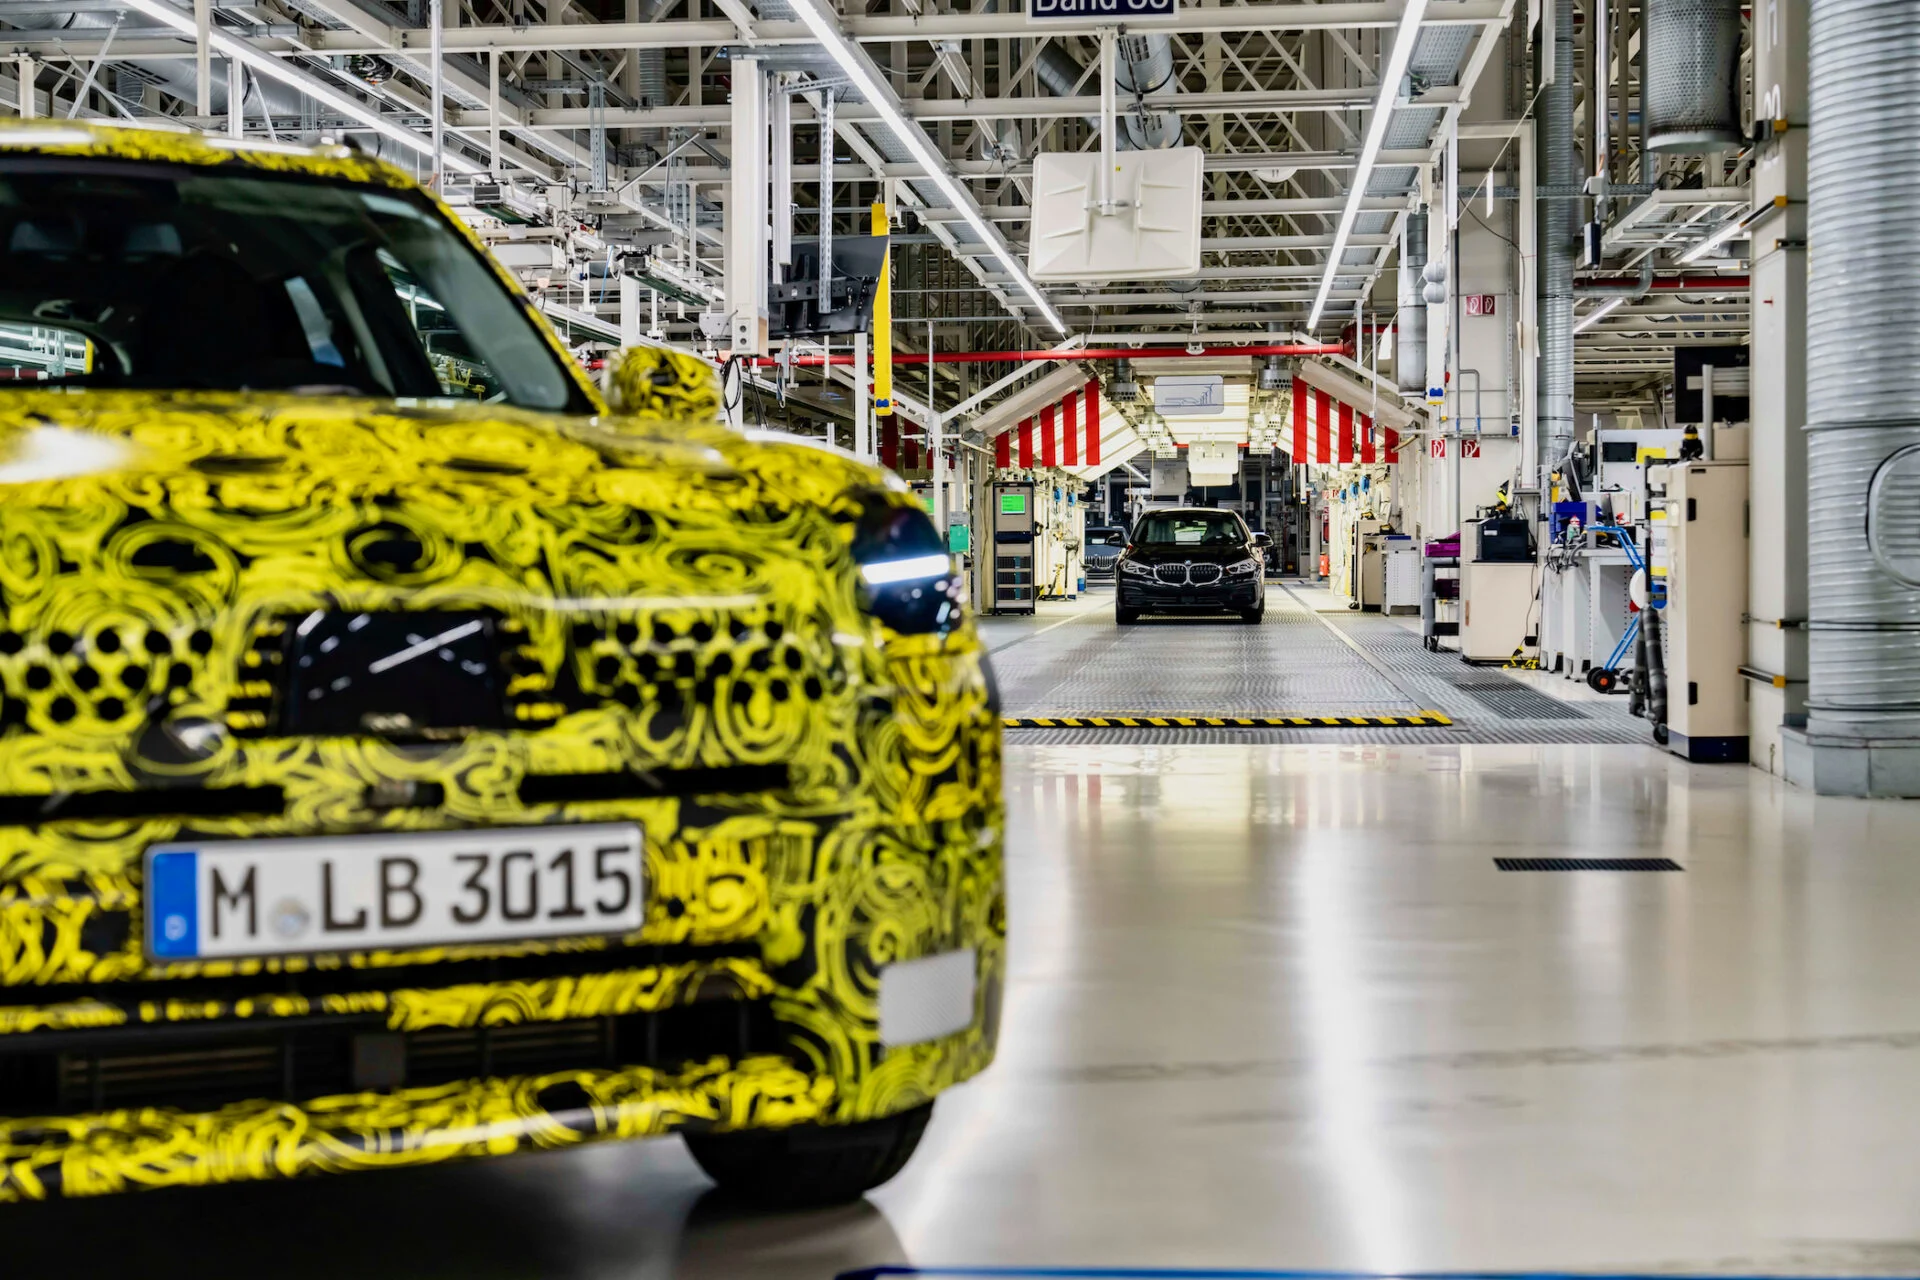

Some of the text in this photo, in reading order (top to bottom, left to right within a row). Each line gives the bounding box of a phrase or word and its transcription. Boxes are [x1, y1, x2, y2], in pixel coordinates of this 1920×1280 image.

[210, 864, 257, 939] M
[321, 857, 425, 933] LB
[451, 845, 633, 925] 3015
